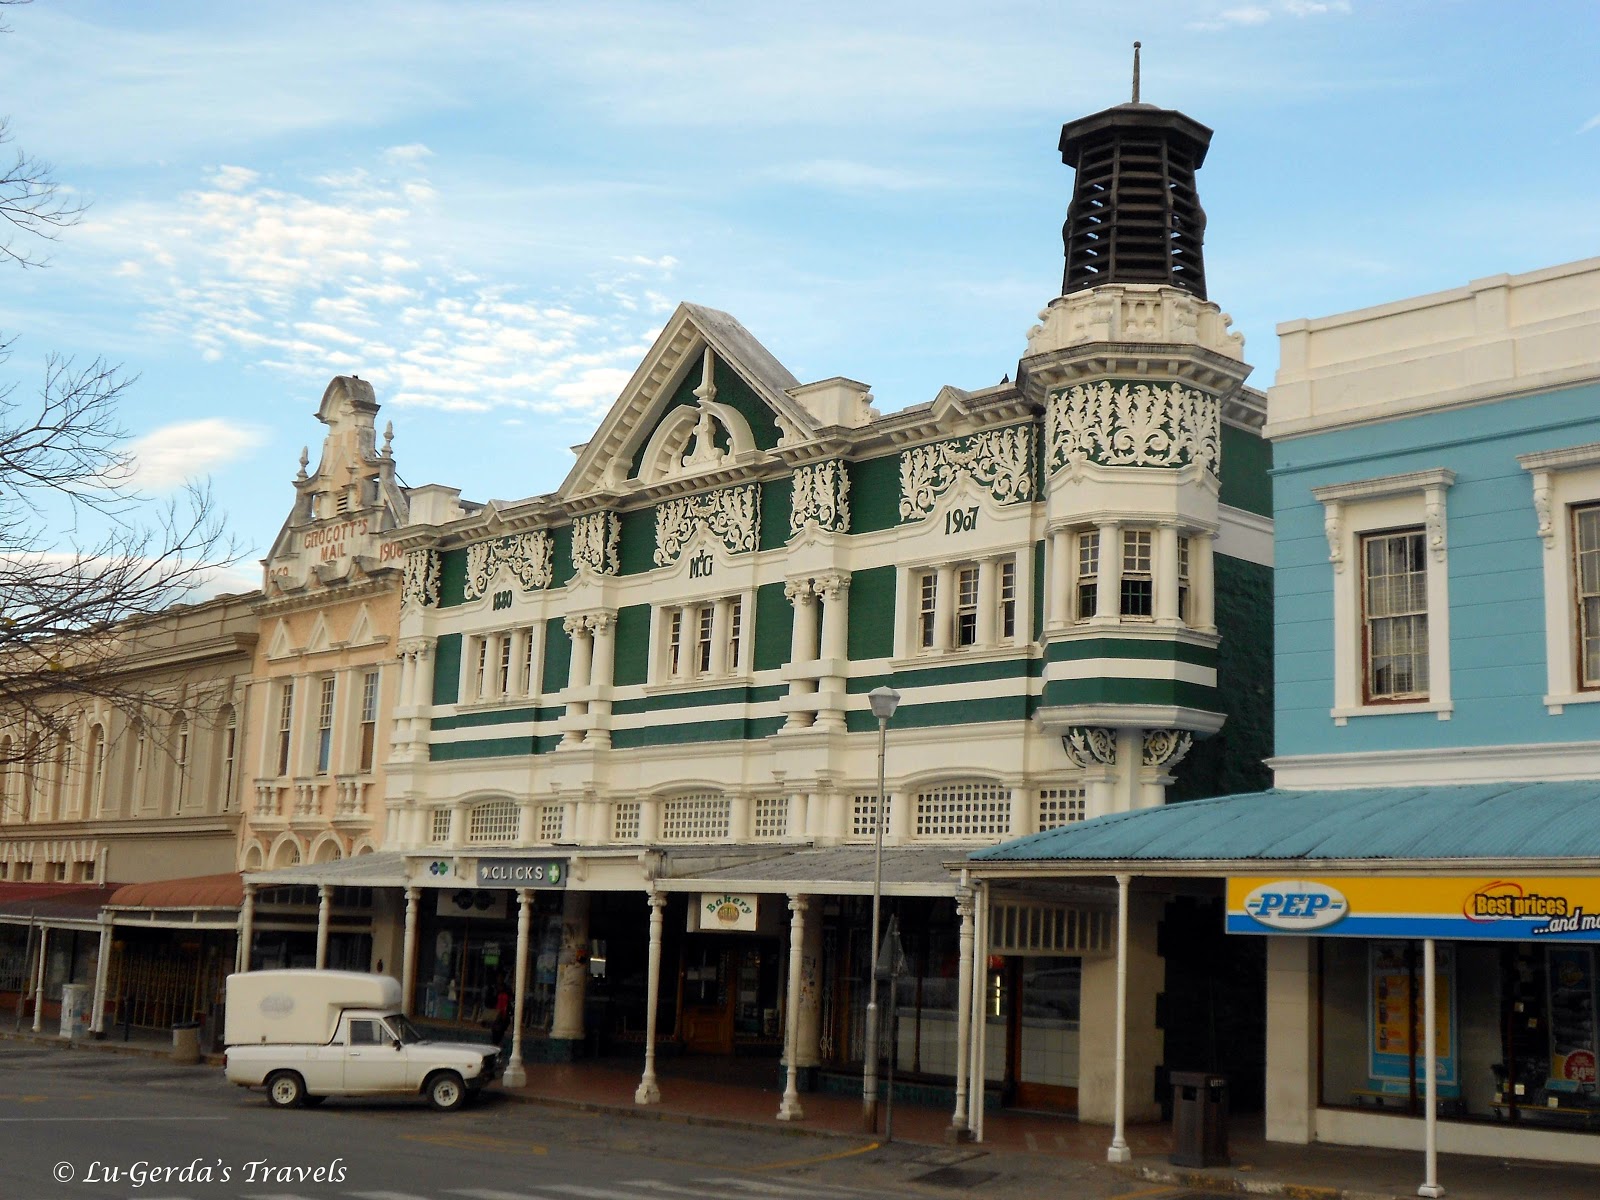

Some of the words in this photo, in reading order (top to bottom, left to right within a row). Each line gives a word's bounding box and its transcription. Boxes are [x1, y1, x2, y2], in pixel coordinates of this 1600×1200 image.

[945, 506, 979, 535] 1907
[304, 518, 368, 549] GROCOTT'S
[321, 543, 346, 561] MAIL
[493, 589, 512, 611] 1880
[491, 866, 543, 881] CLICKS
[706, 894, 752, 914] Bakery
[1254, 893, 1330, 919] PEP
[1475, 894, 1513, 915] Best
[1513, 895, 1567, 917] prices
